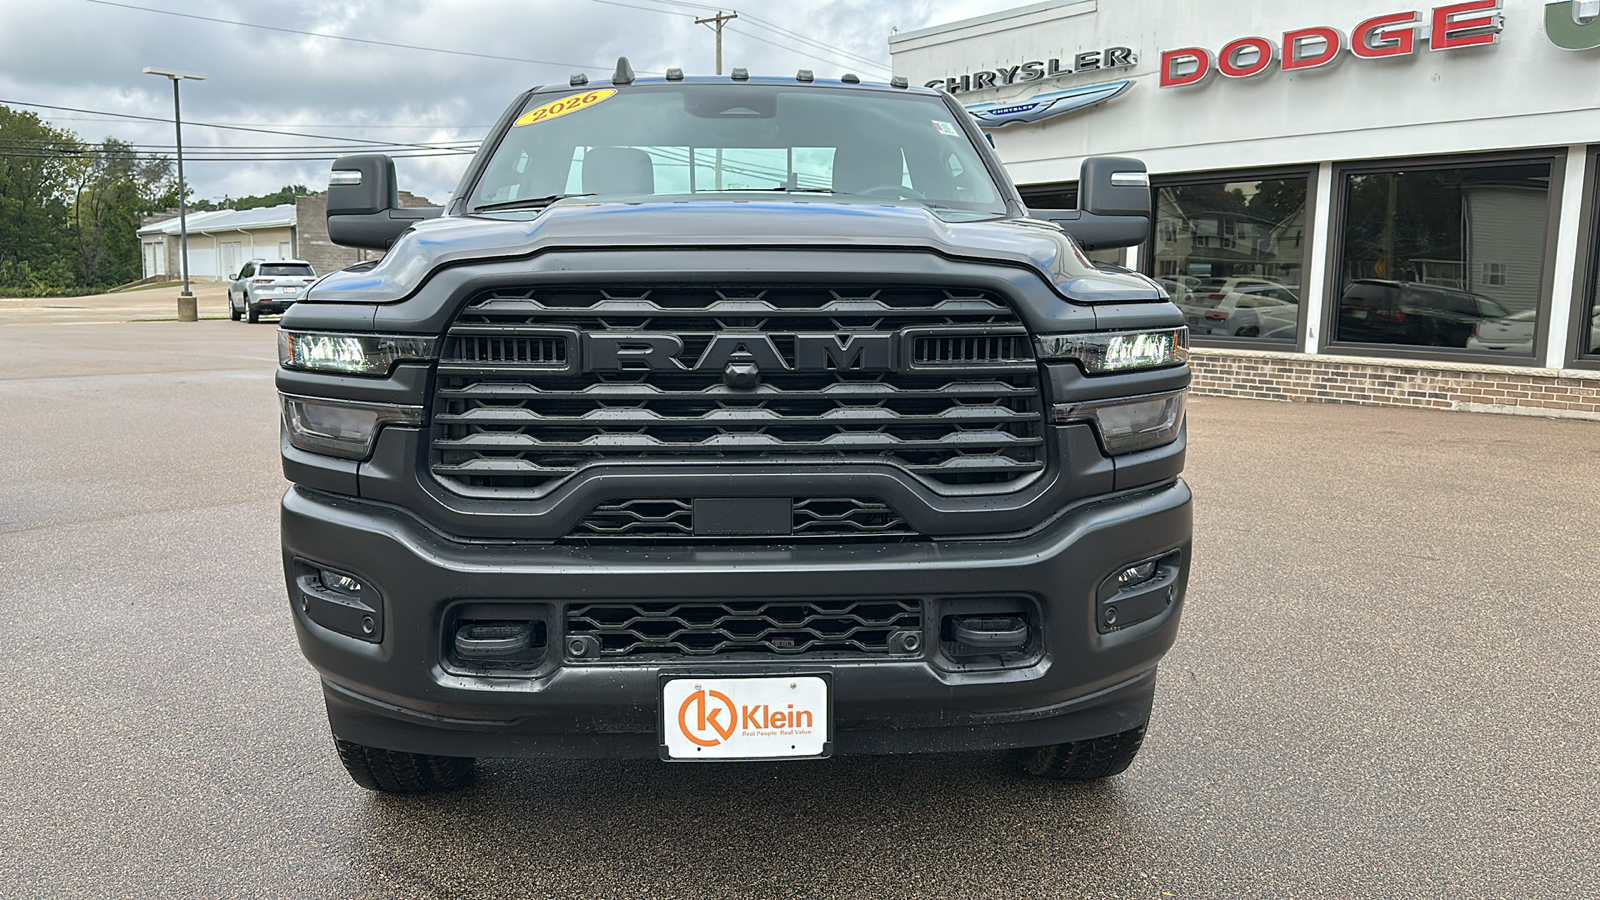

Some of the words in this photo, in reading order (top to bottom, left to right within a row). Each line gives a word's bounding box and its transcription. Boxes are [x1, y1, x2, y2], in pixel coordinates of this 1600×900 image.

[1160, 0, 1500, 88] DODGE
[533, 91, 598, 122] 2026
[588, 332, 894, 372] RAM
[742, 704, 813, 730] Klein
